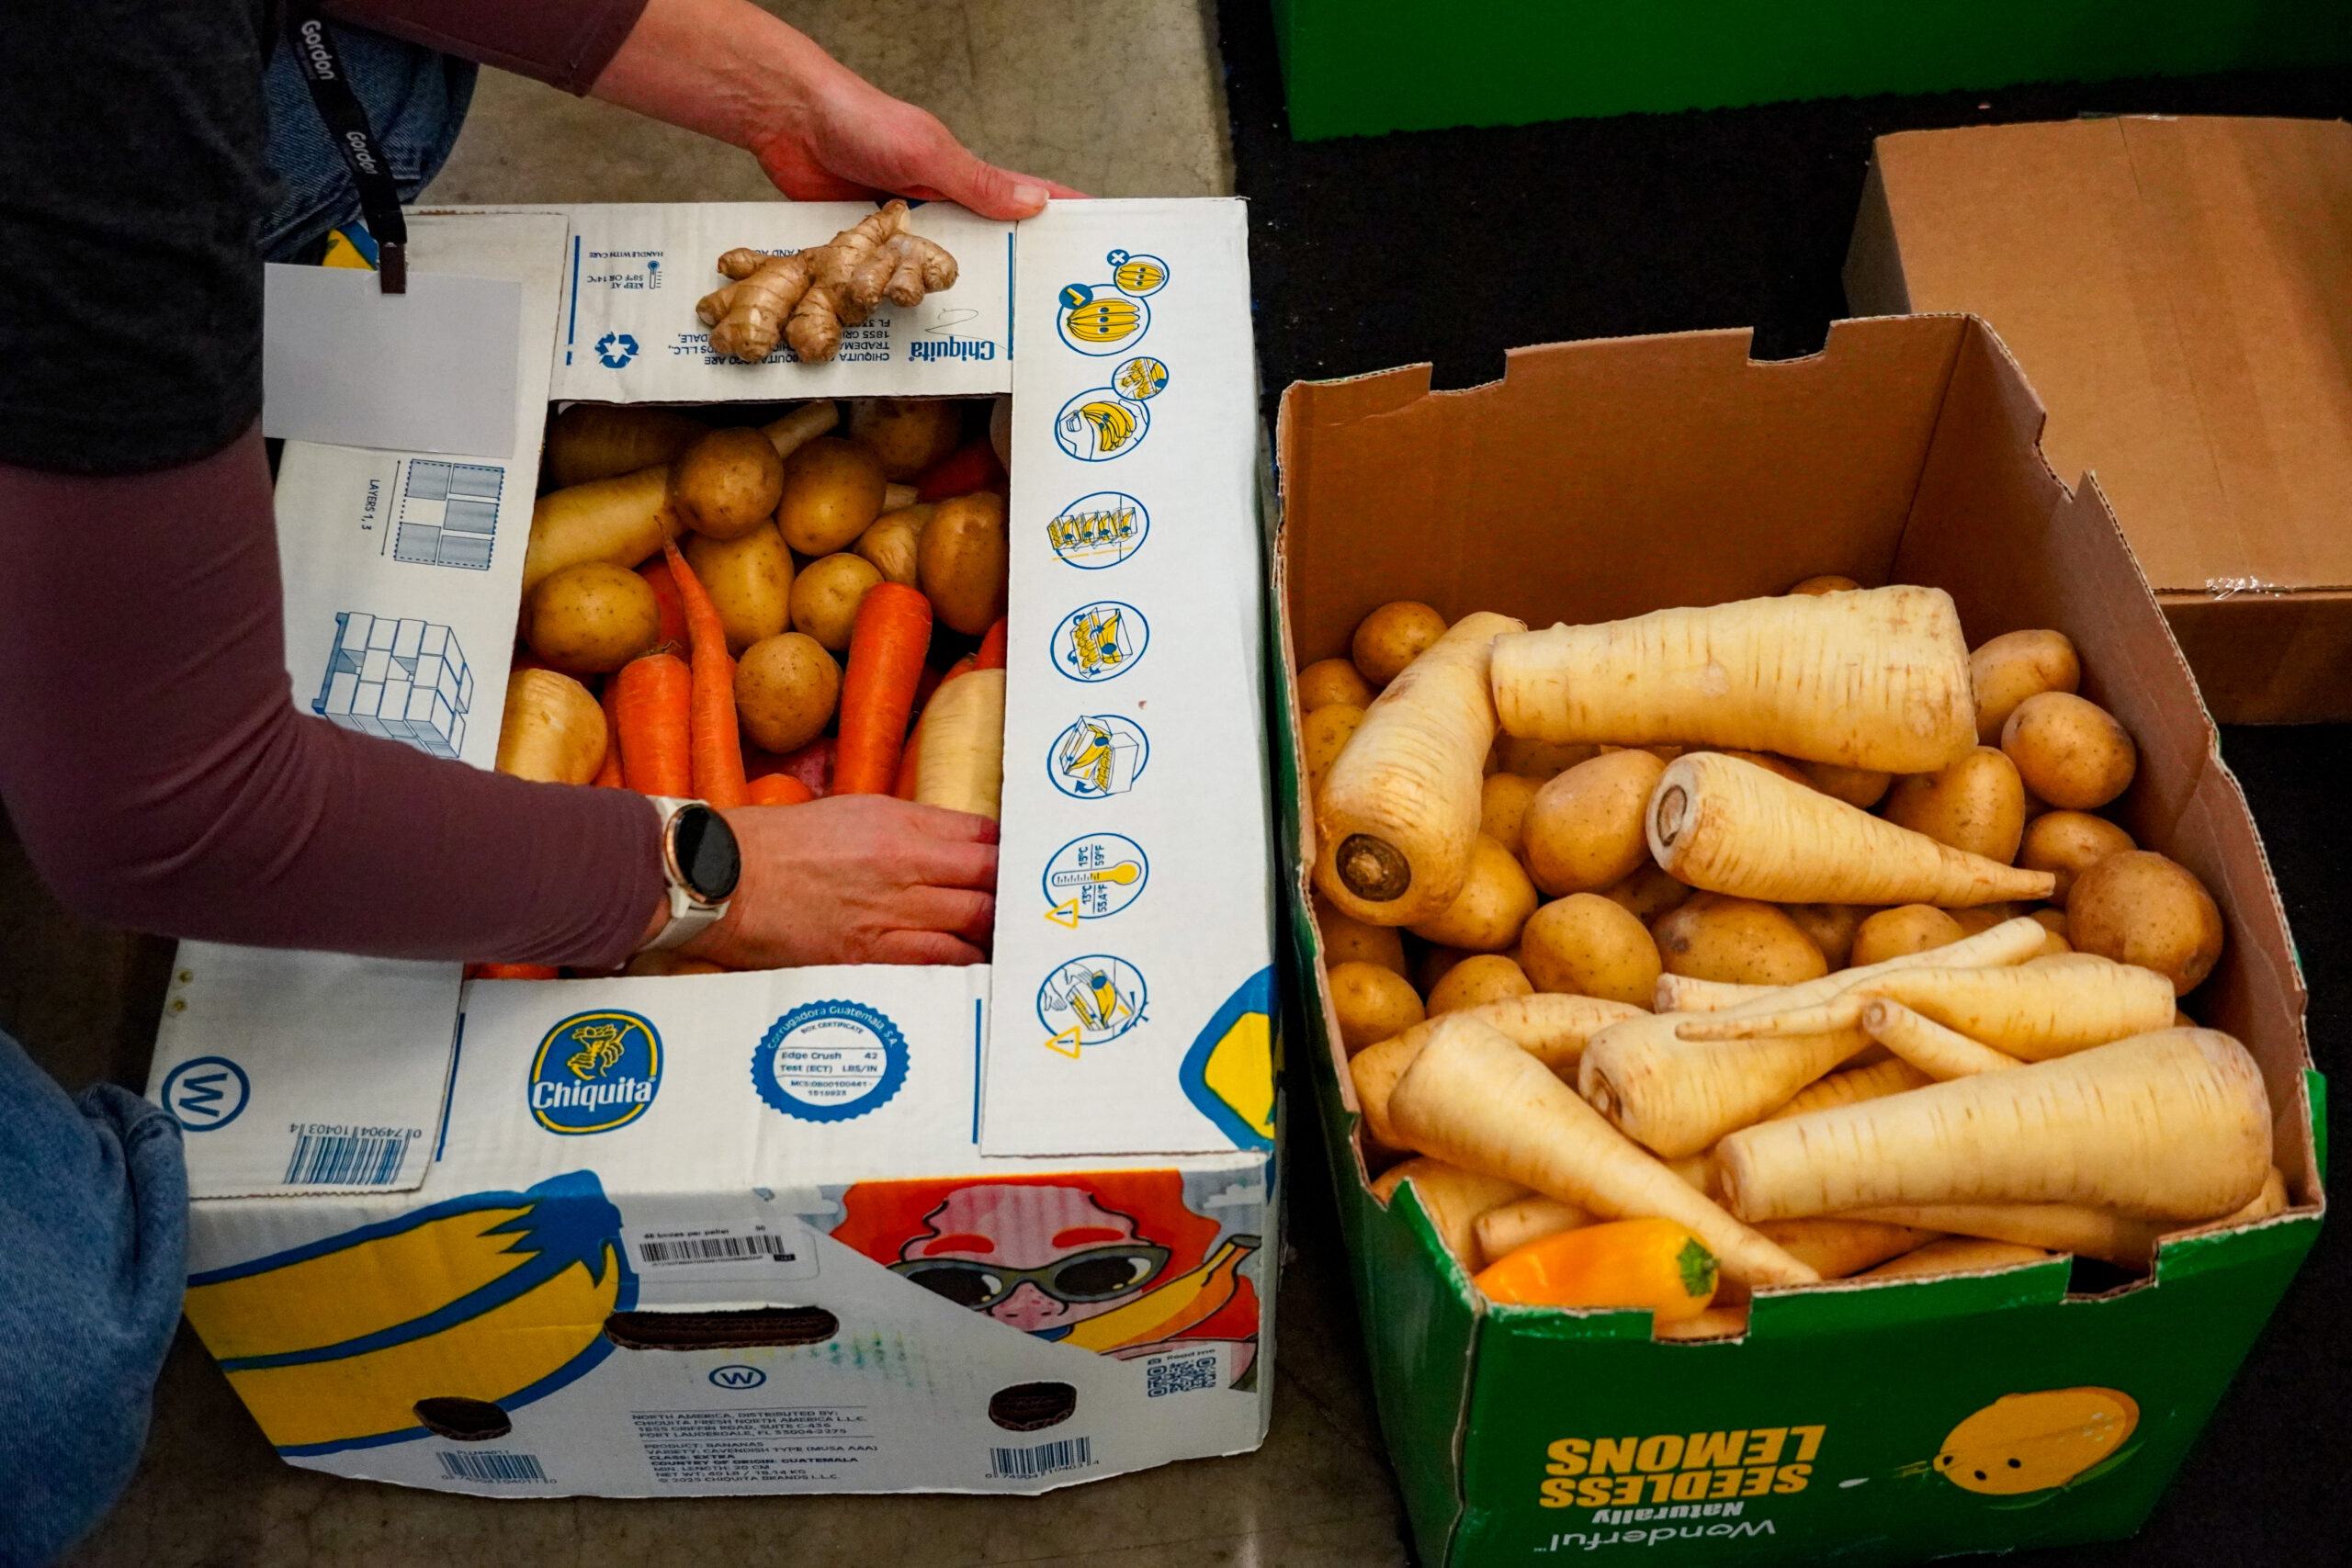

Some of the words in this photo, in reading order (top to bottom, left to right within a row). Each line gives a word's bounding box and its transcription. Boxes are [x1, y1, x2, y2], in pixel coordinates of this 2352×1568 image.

[300, 19, 336, 81] Gordon
[864, 331, 890, 339] 1855
[910, 335, 995, 362] Chiquita
[704, 355, 727, 365] ARE
[840, 353, 889, 362] CHIQUITA
[365, 479, 380, 513] LAYERS
[767, 1008, 827, 1049] Corrugadora
[800, 1025, 817, 1034] BOX
[818, 1021, 865, 1035] CERTIFICATE
[781, 1052, 808, 1060] Edge
[810, 1052, 842, 1060] Crush
[864, 1052, 877, 1060] 42
[780, 1064, 803, 1072] Test
[806, 1065, 833, 1074] (ECT)
[842, 1065, 877, 1073] LBS/IN
[532, 1076, 653, 1112] Chiquita
[289, 1122, 299, 1134] 4
[308, 1123, 349, 1135] 10403
[361, 1126, 403, 1138] 74904
[413, 1129, 422, 1139] 0
[738, 1410, 816, 1418] DISTRIBUTED
[1545, 1424, 1826, 1476] LEMONS
[1539, 1463, 1813, 1508] SEEDLESS
[1591, 1501, 1745, 1525] Naturally
[1550, 1519, 1776, 1552] Wonderful
